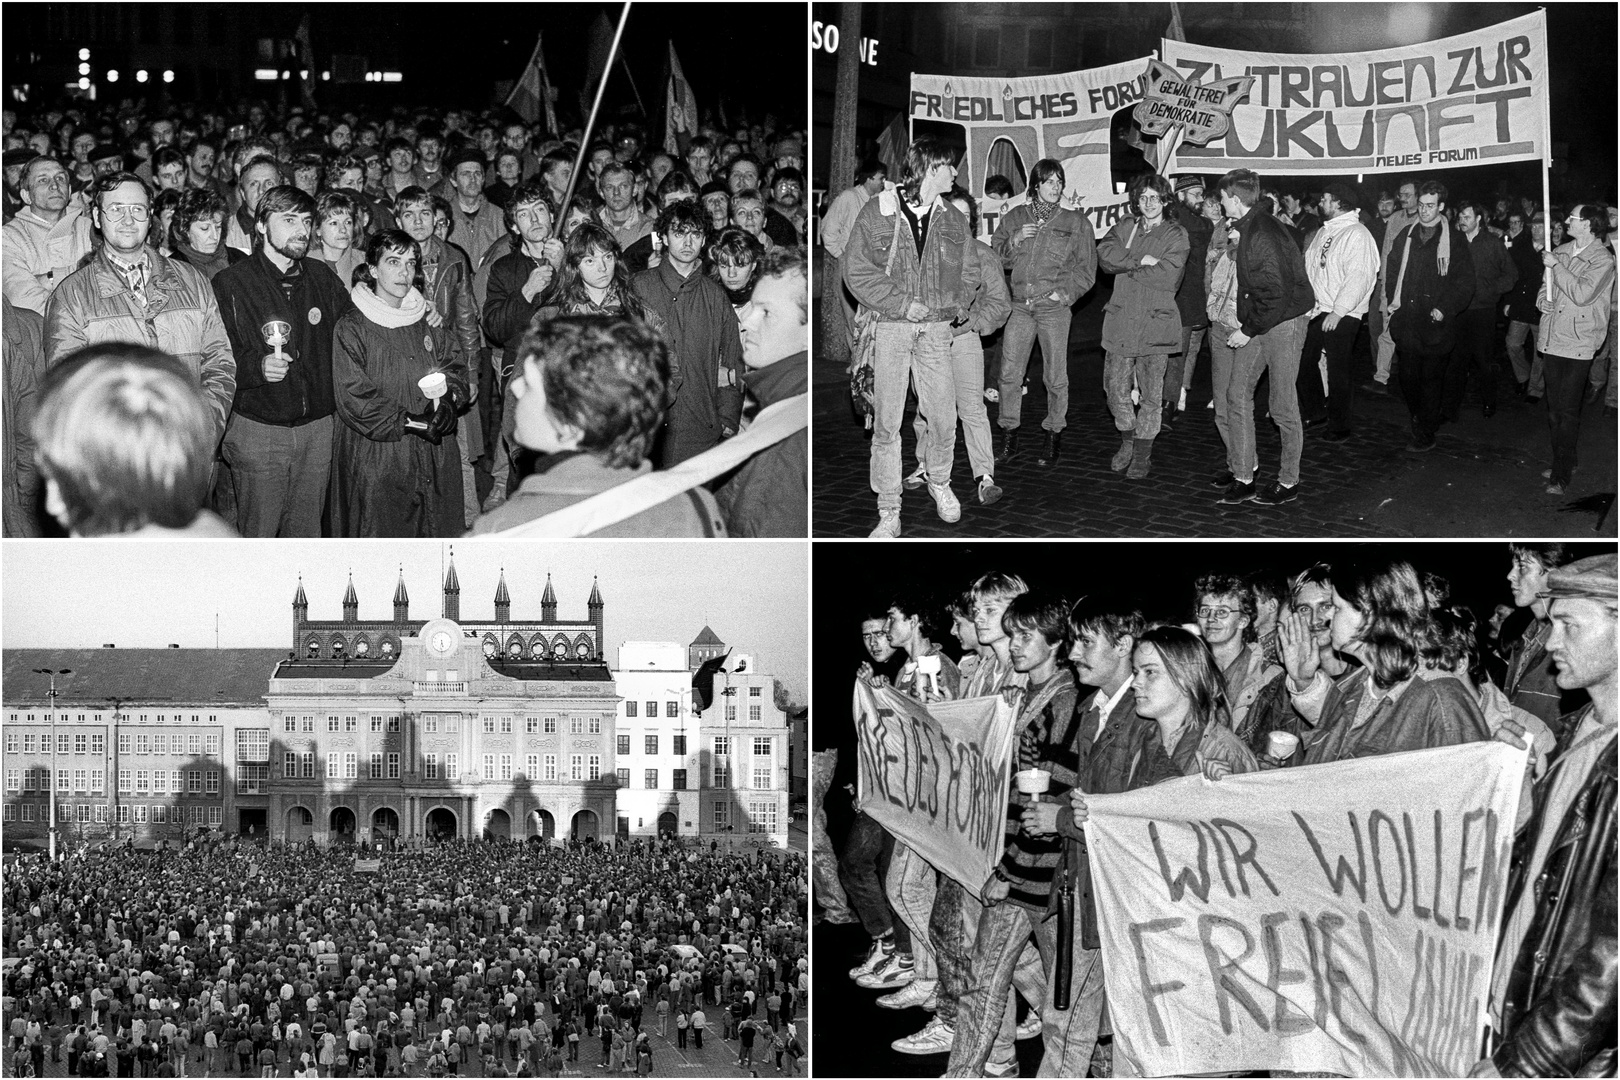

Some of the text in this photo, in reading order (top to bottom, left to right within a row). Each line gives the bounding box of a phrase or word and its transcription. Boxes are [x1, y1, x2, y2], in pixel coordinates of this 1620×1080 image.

[1087, 74, 1146, 114] FORU
[1159, 80, 1226, 105] GEWALTFREI
[1176, 35, 1532, 108] ZTRAUEN ZUR
[1149, 102, 1216, 128] DEMOKRATIE
[1376, 147, 1477, 167] NEUES FORUM
[858, 707, 1005, 864] NEUES FORUM
[1148, 808, 1508, 934] WIR WOLLEN
[1128, 911, 1367, 1047] FREIE
